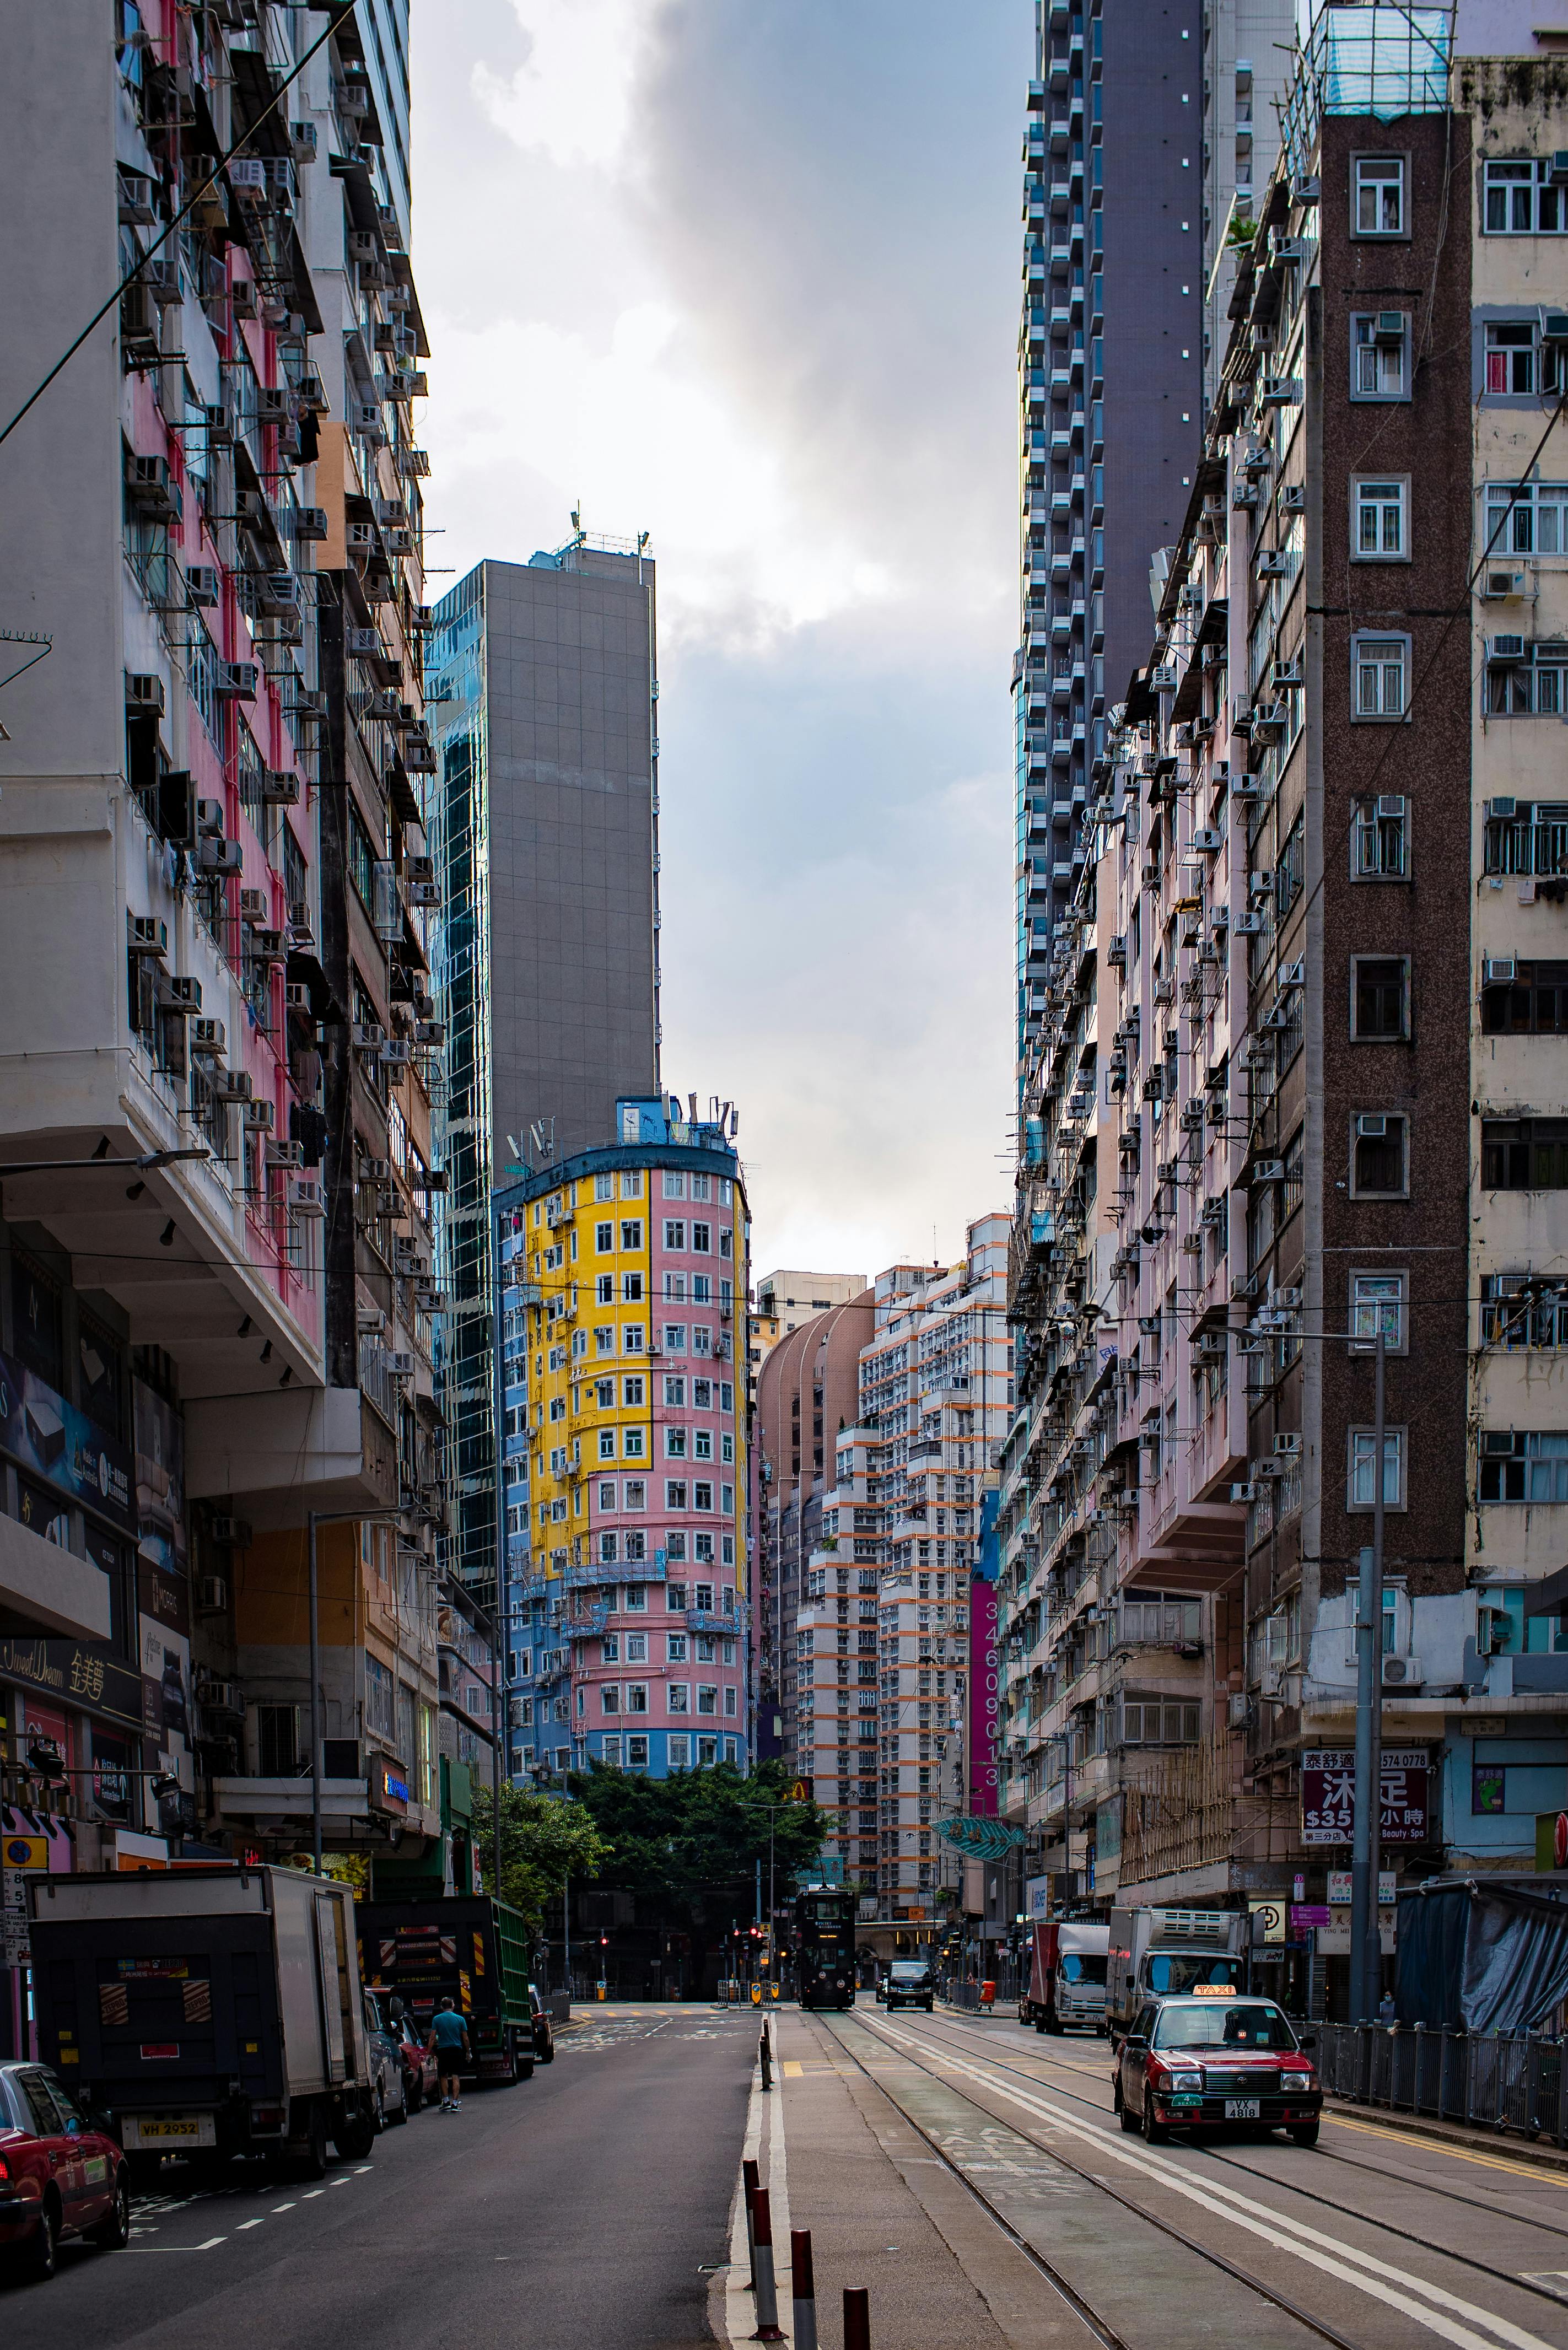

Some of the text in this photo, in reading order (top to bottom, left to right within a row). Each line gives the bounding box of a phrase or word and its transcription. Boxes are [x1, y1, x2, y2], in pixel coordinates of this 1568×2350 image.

[159, 1587, 177, 1615] MORRIS
[1306, 1753, 1426, 1769] 泰舒適 574 0778
[1305, 1832, 1341, 1841] 第三分店
[1382, 1829, 1407, 1840] Beauty
[1410, 1829, 1424, 1839] Spa
[1198, 1986, 1232, 1994] TAXI
[103, 1997, 126, 2013] ZEPRO
[185, 1995, 208, 2012] ZEPRO
[1235, 2100, 1249, 2109] VX
[1229, 2109, 1256, 2117] 4818
[143, 2123, 196, 2135] VH 2952
